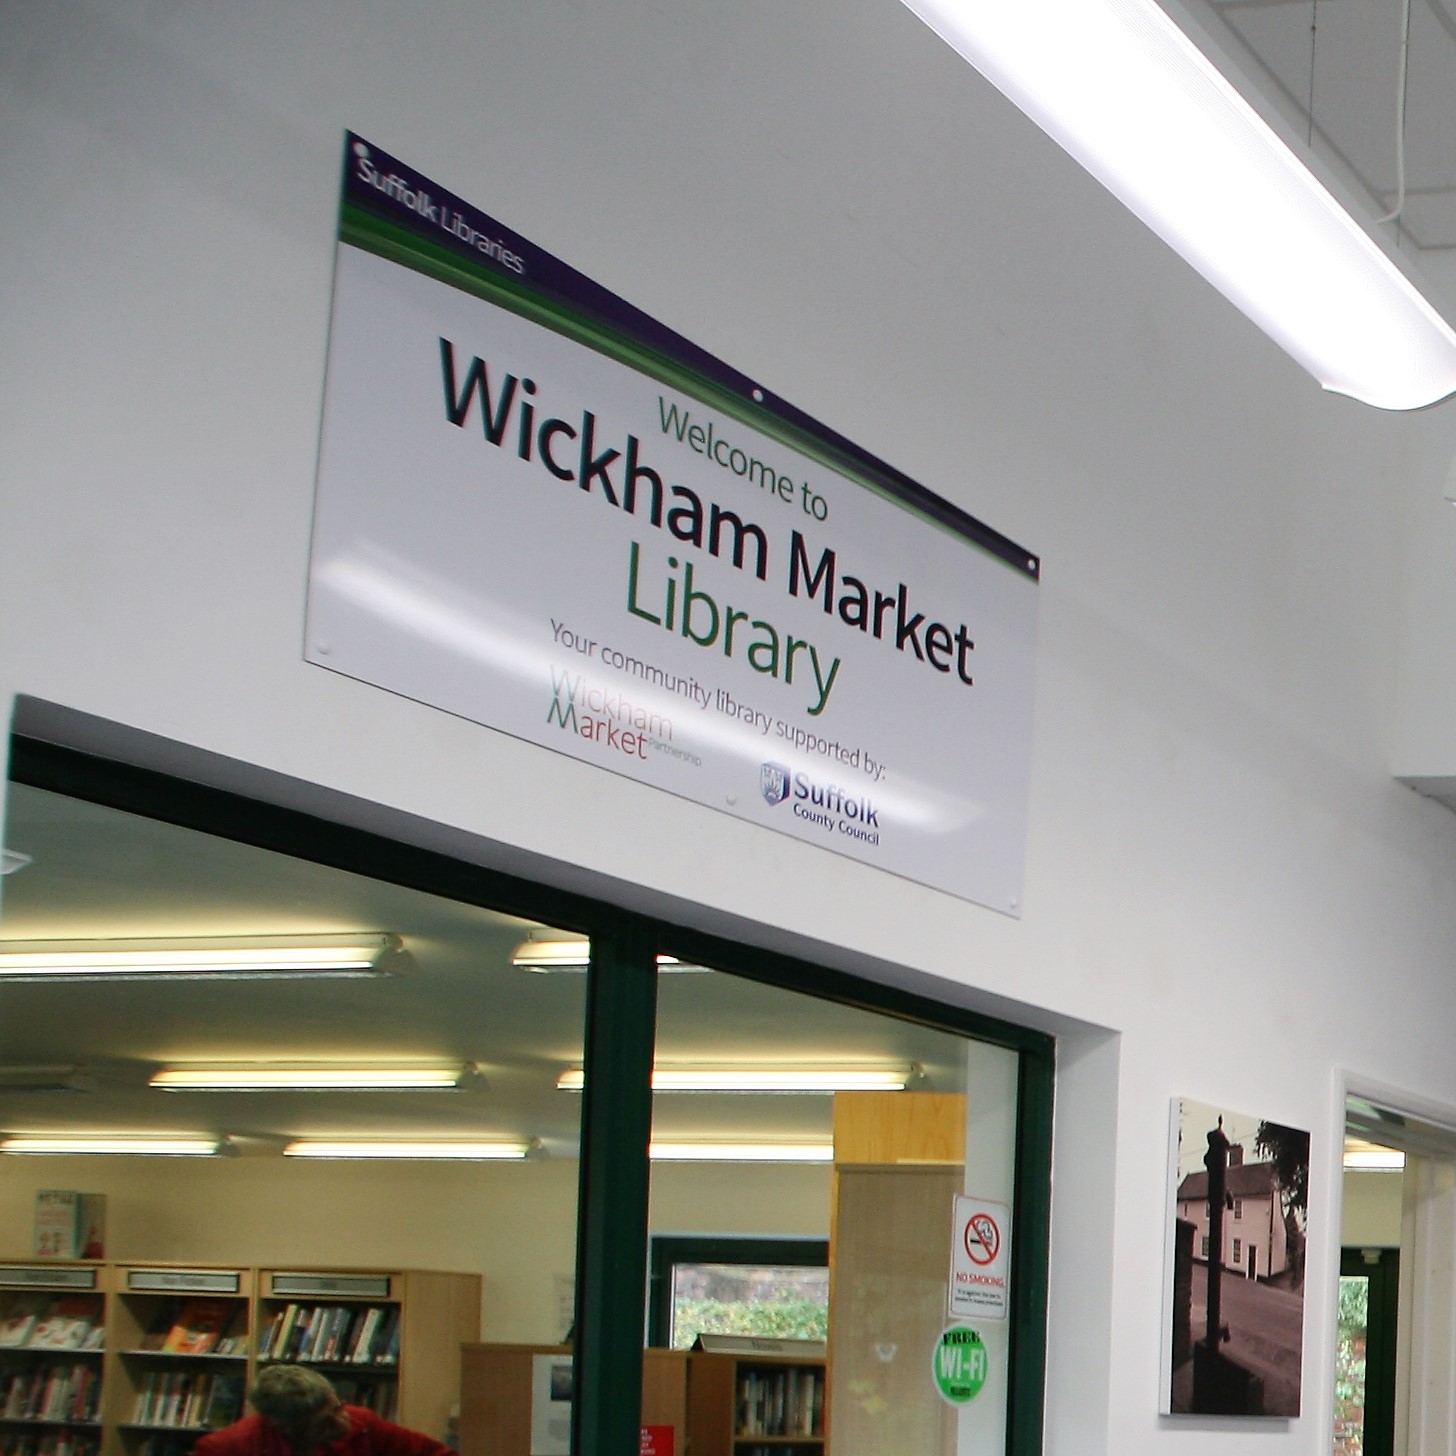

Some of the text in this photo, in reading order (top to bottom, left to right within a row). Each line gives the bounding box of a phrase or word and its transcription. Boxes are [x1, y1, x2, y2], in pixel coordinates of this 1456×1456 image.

[357, 156, 525, 274] Suffolk Libraries
[657, 395, 829, 522] Welcome to
[439, 336, 975, 686] Wickham Market
[626, 541, 841, 716] Library
[546, 698, 702, 767] Market Partnership
[549, 665, 675, 741] Wickham
[550, 618, 888, 781] Your community library supported by:
[793, 772, 880, 829] Suffolk
[793, 803, 880, 846] County Council
[939, 1346, 987, 1380] WI-FI
[943, 1331, 980, 1346] FREE
